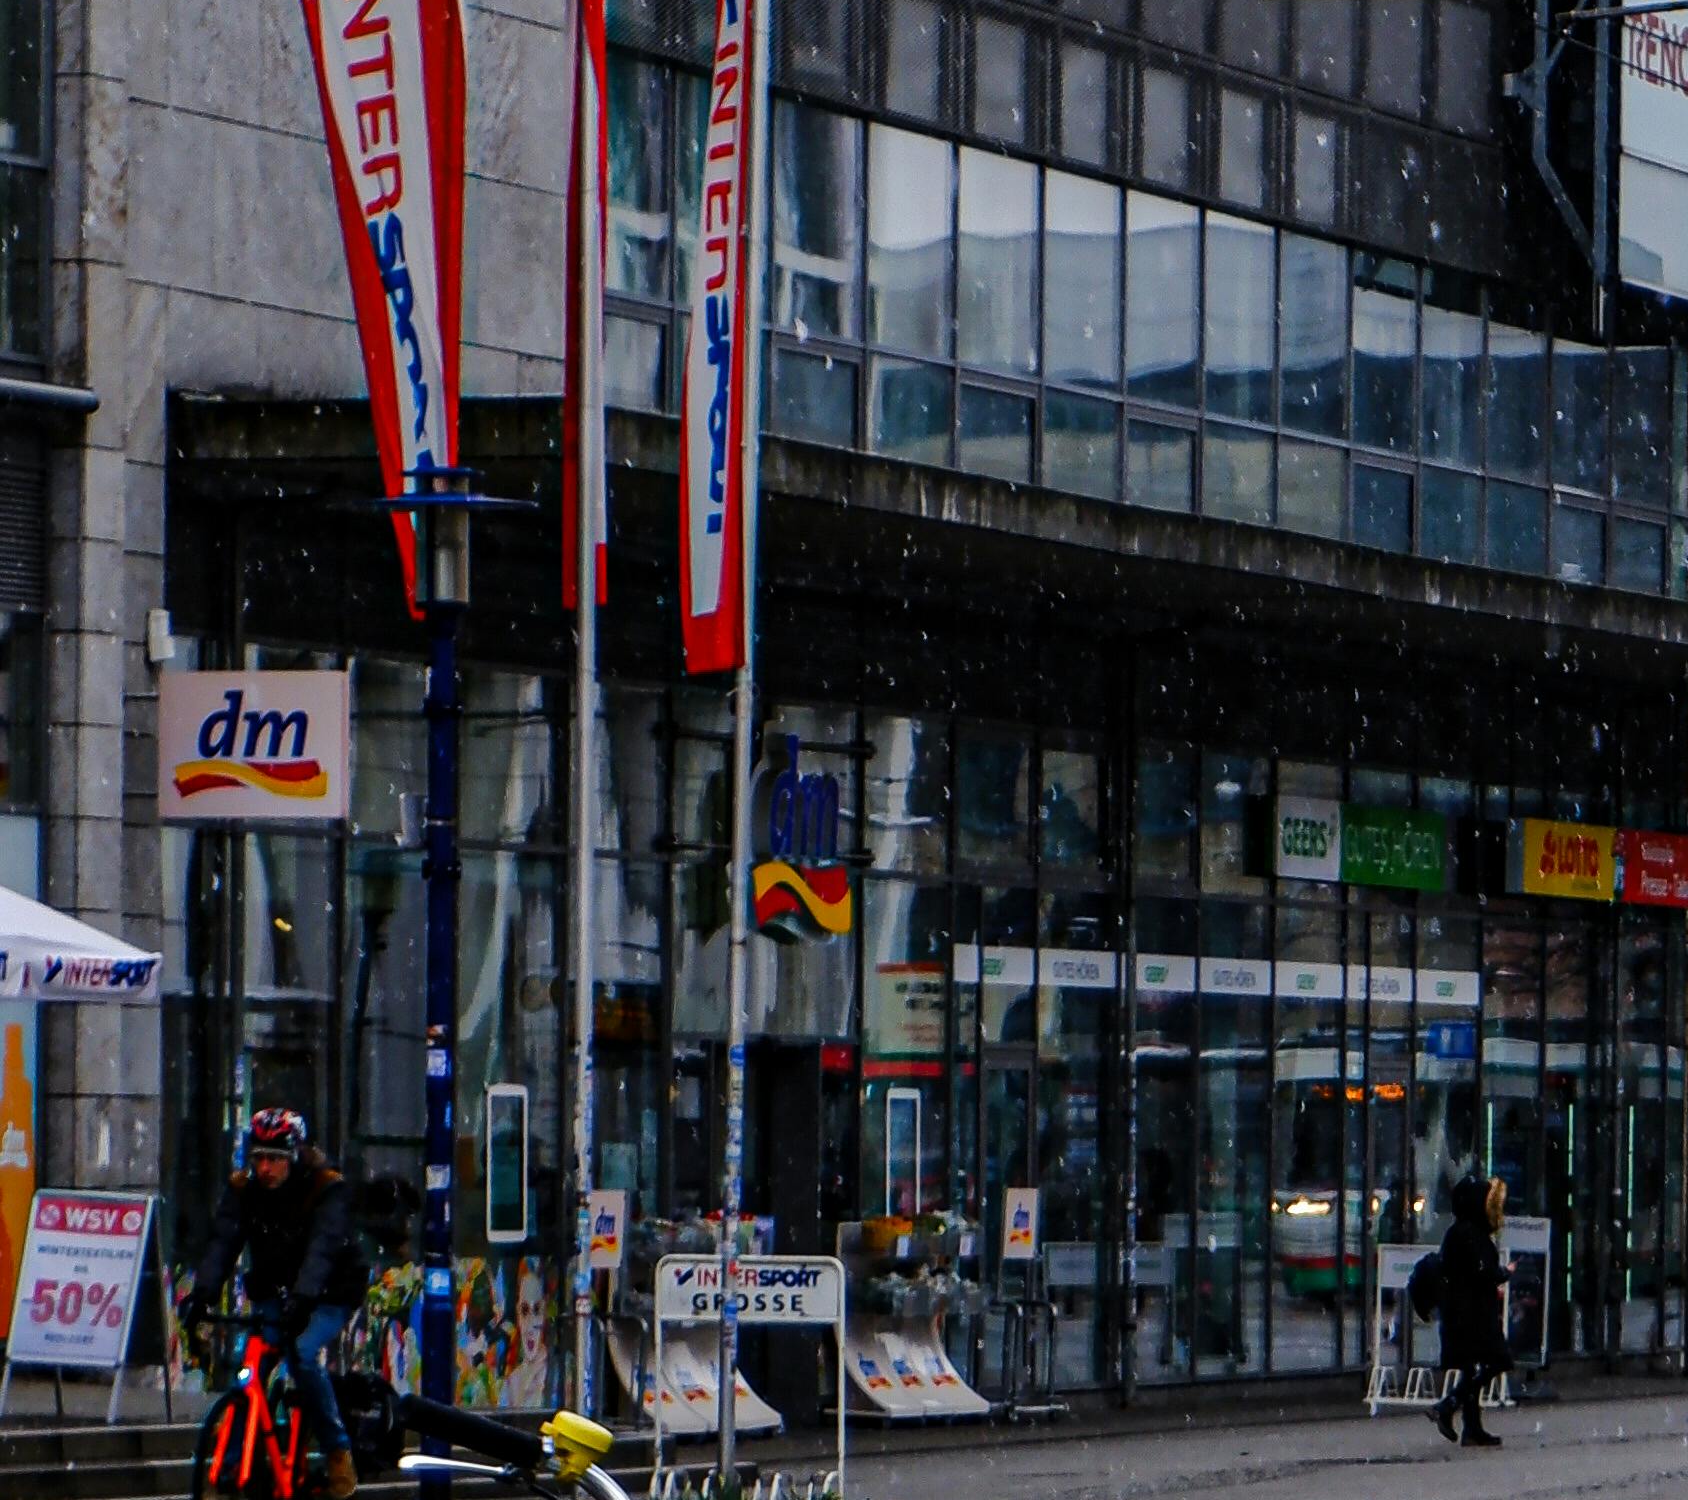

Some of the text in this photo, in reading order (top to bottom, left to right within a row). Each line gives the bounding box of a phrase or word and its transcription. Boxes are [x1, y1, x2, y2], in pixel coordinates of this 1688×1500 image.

[196, 688, 309, 759] dm
[769, 733, 840, 857] dm
[1282, 816, 1328, 859] GEERS
[1557, 834, 1600, 878] LOTTO
[62, 957, 158, 989] INTERSPORT
[64, 1205, 118, 1231] WSV
[30, 1278, 124, 1329] 50%
